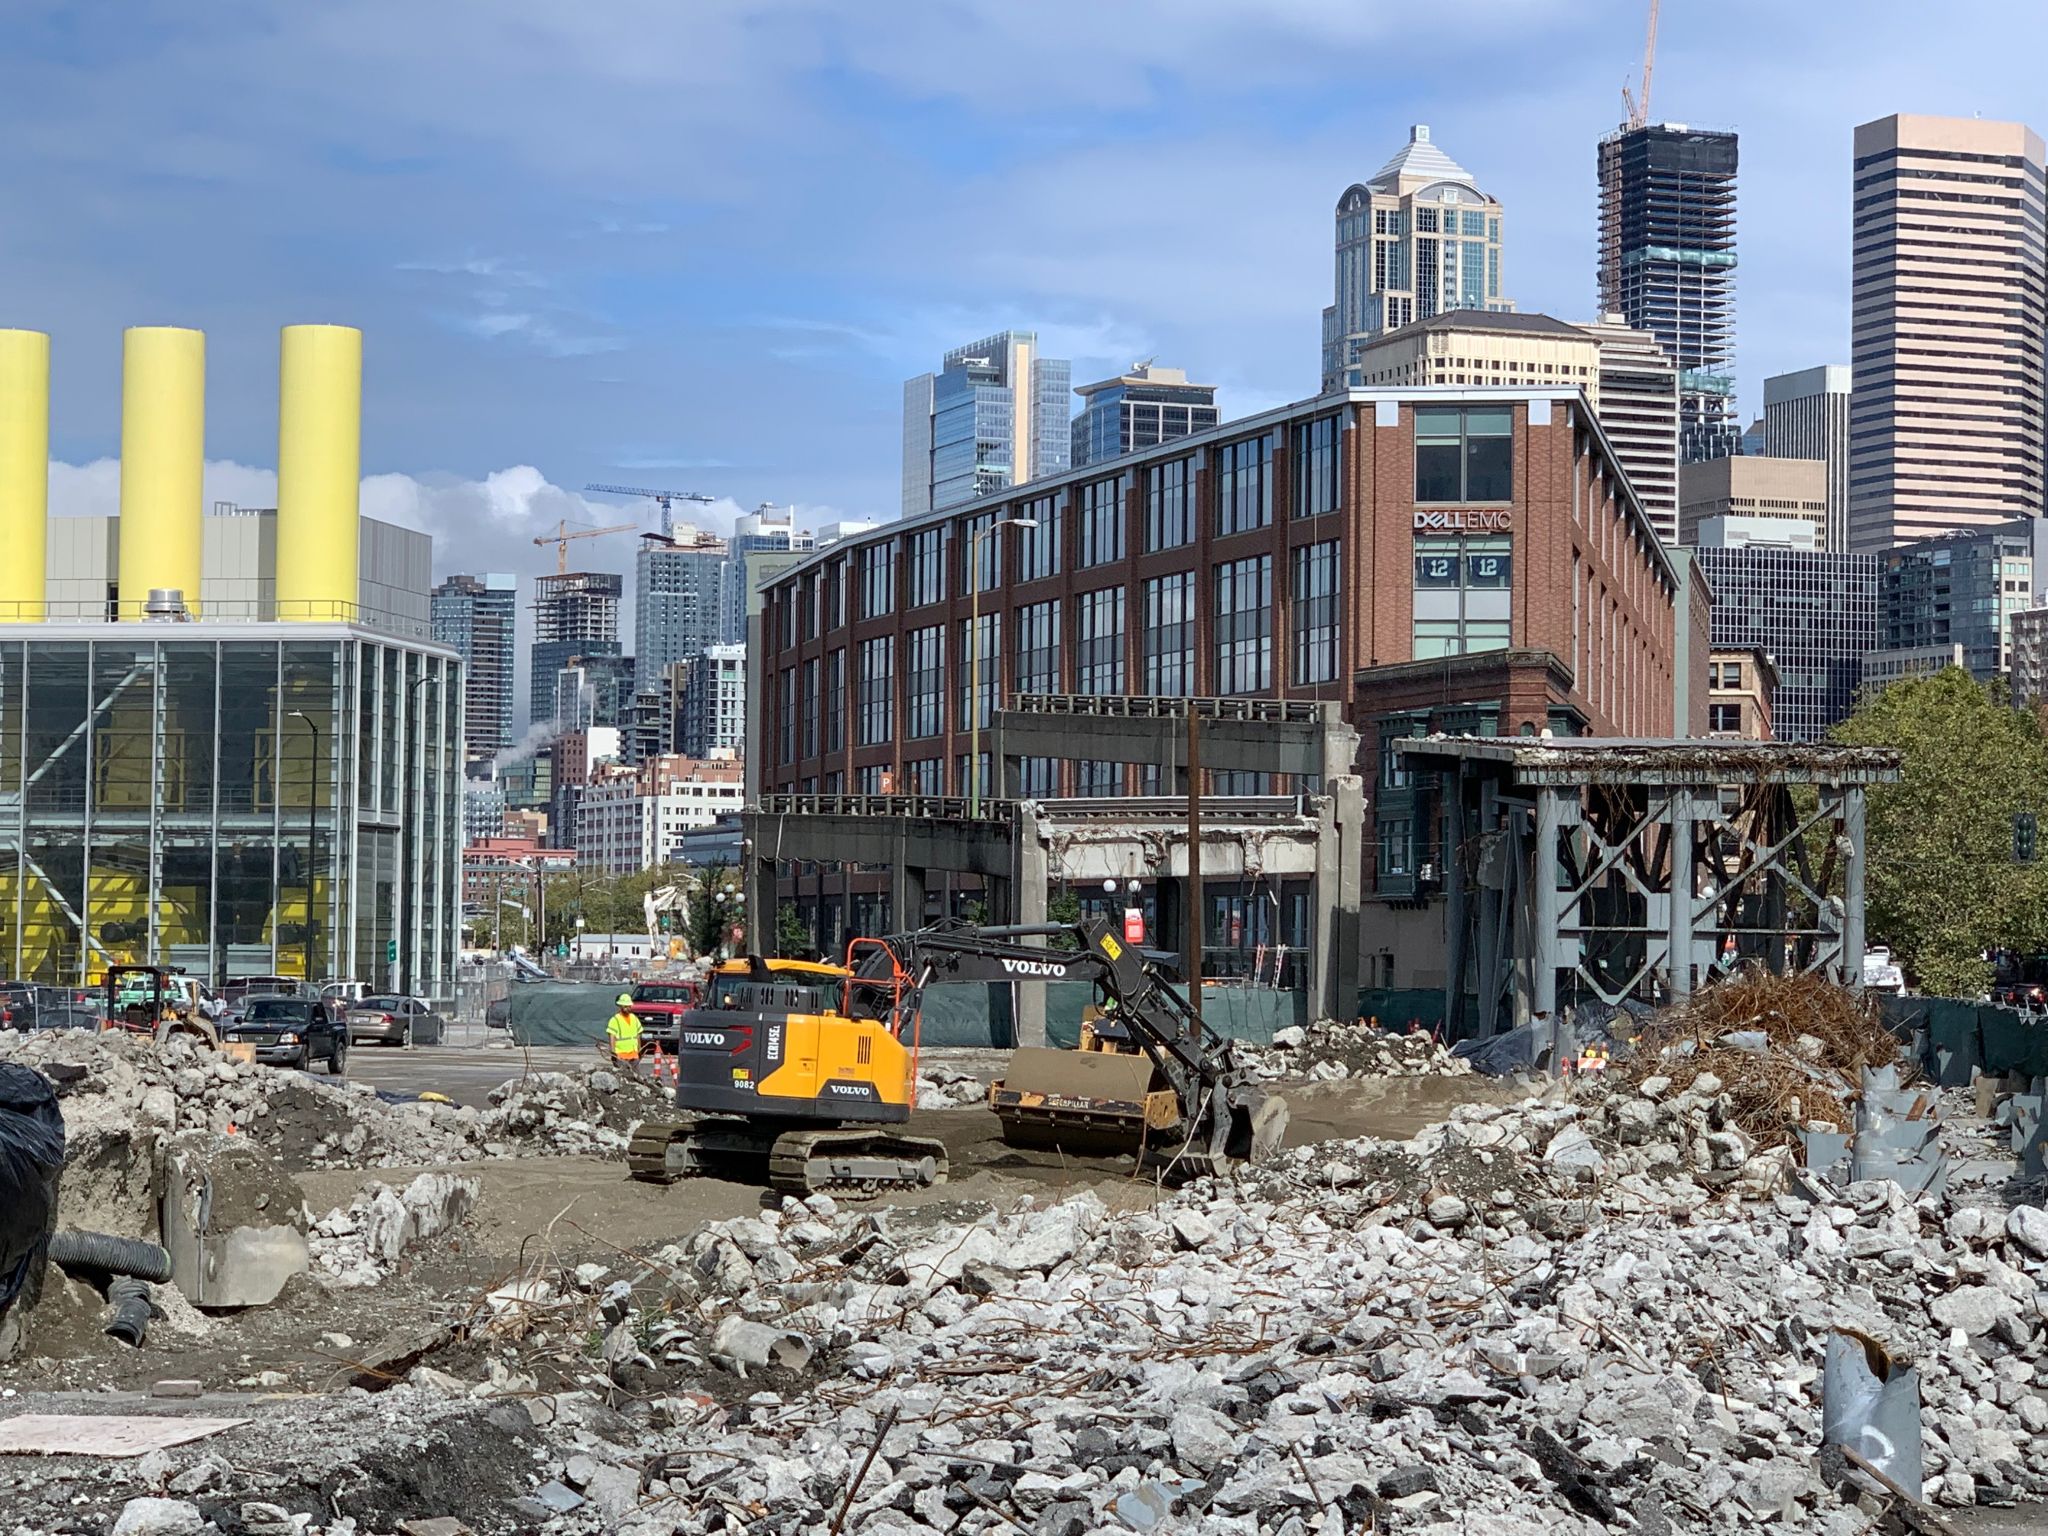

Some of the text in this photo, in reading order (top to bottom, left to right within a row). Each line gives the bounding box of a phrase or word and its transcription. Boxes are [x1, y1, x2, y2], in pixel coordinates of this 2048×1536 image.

[1430, 559, 1448, 577] 12
[1479, 558, 1497, 576] 12
[882, 777, 890, 788] P
[1001, 958, 1066, 977] VOLVO
[684, 1032, 725, 1046] VOLVO
[735, 1079, 755, 1089] 9082
[830, 1085, 870, 1096] VOLVO
